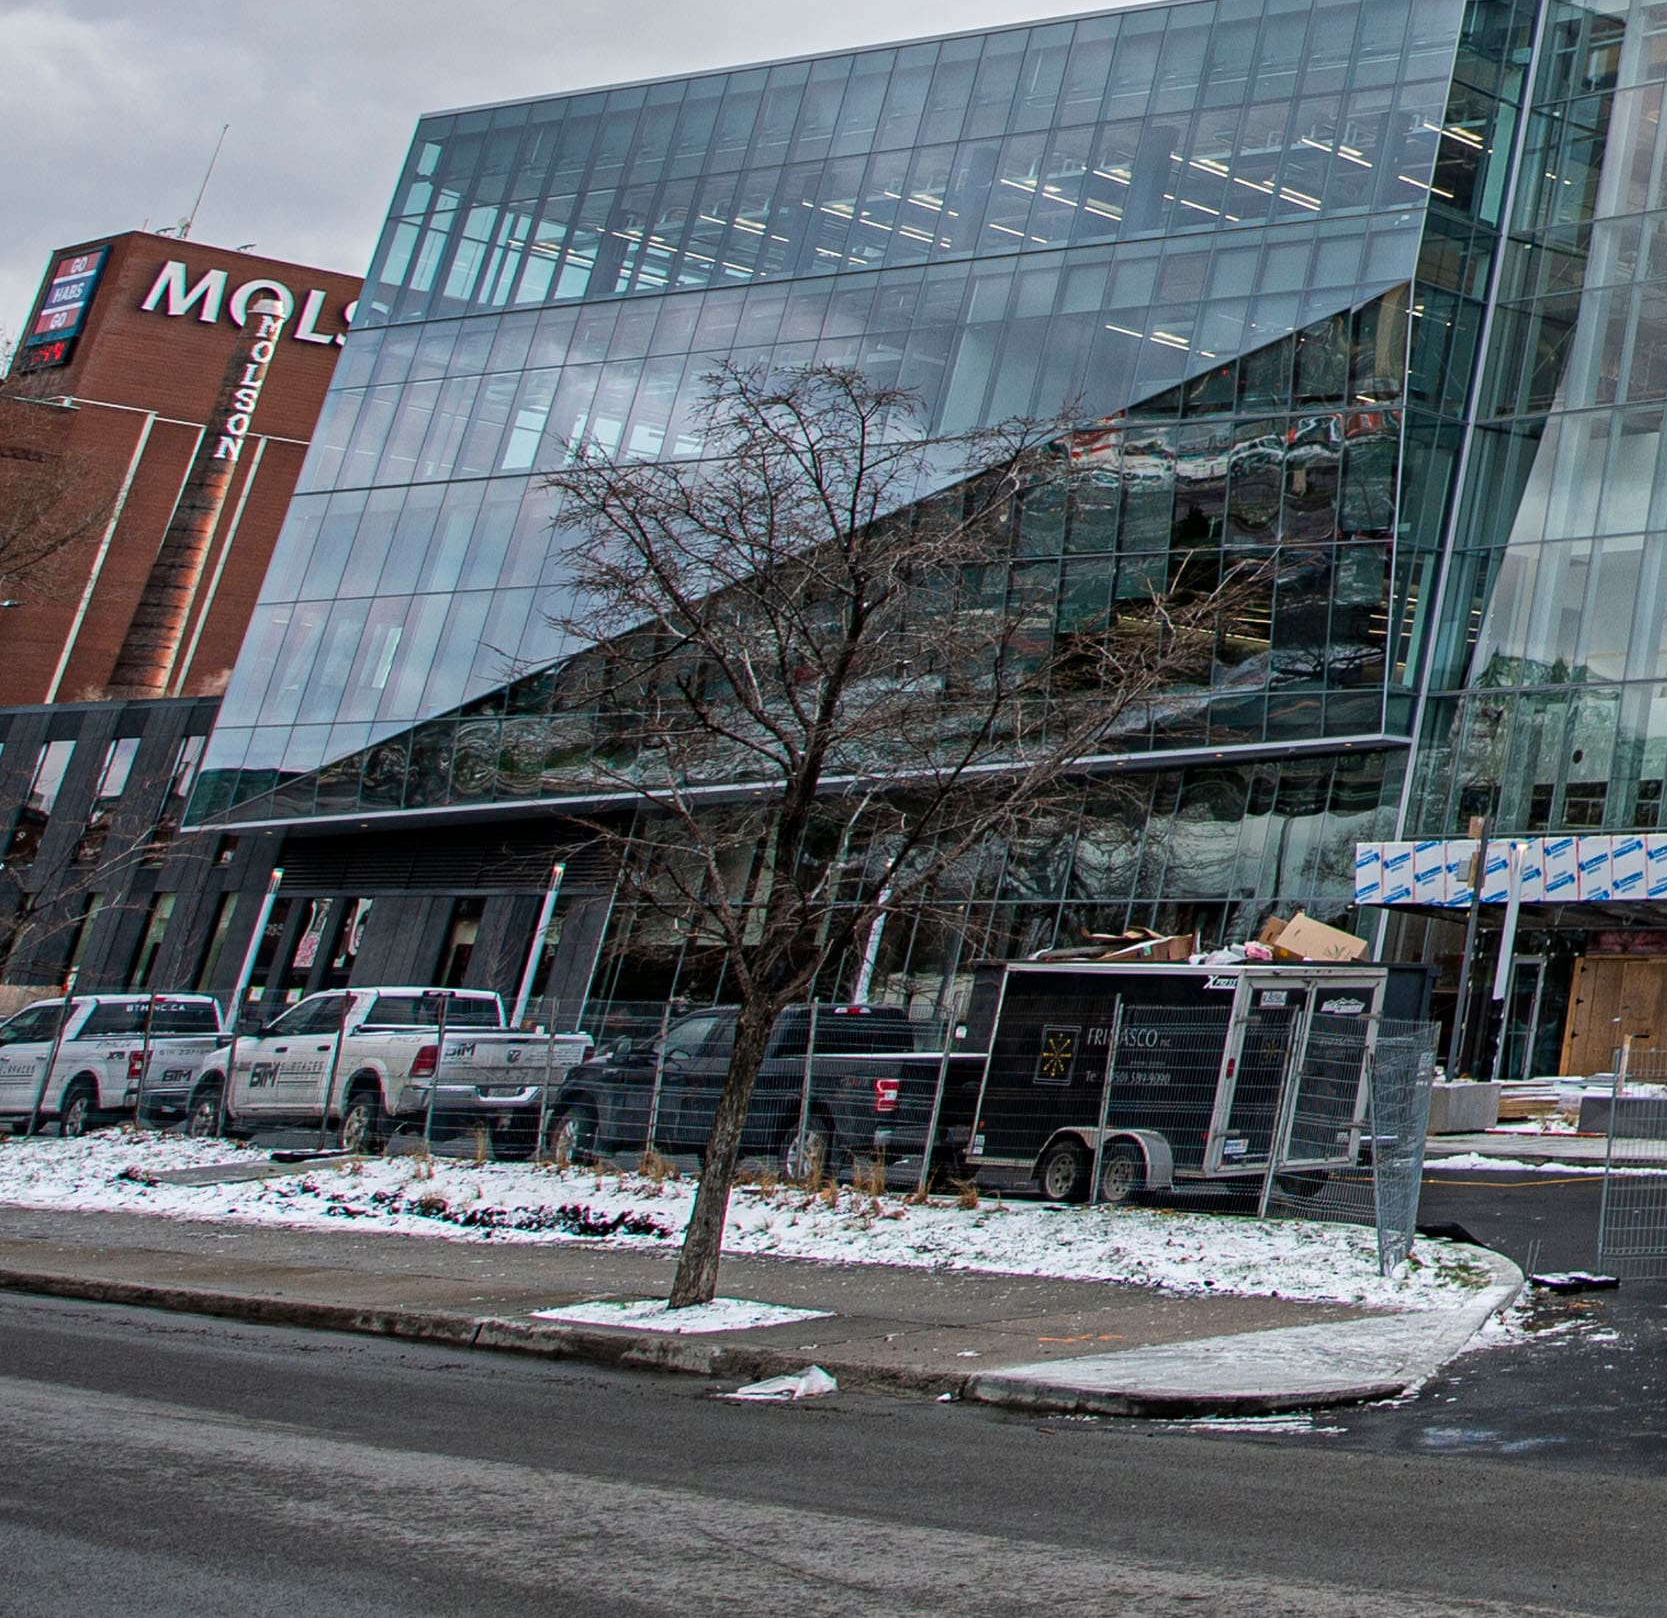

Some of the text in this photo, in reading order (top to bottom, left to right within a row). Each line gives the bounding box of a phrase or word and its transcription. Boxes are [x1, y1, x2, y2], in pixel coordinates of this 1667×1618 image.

[70, 256, 88, 274] GO
[52, 282, 85, 304] HABS
[49, 312, 67, 330] GO
[213, 314, 286, 461] MOLSON
[1087, 1028, 1158, 1047] FRIASCO
[162, 1069, 193, 1081] BTM
